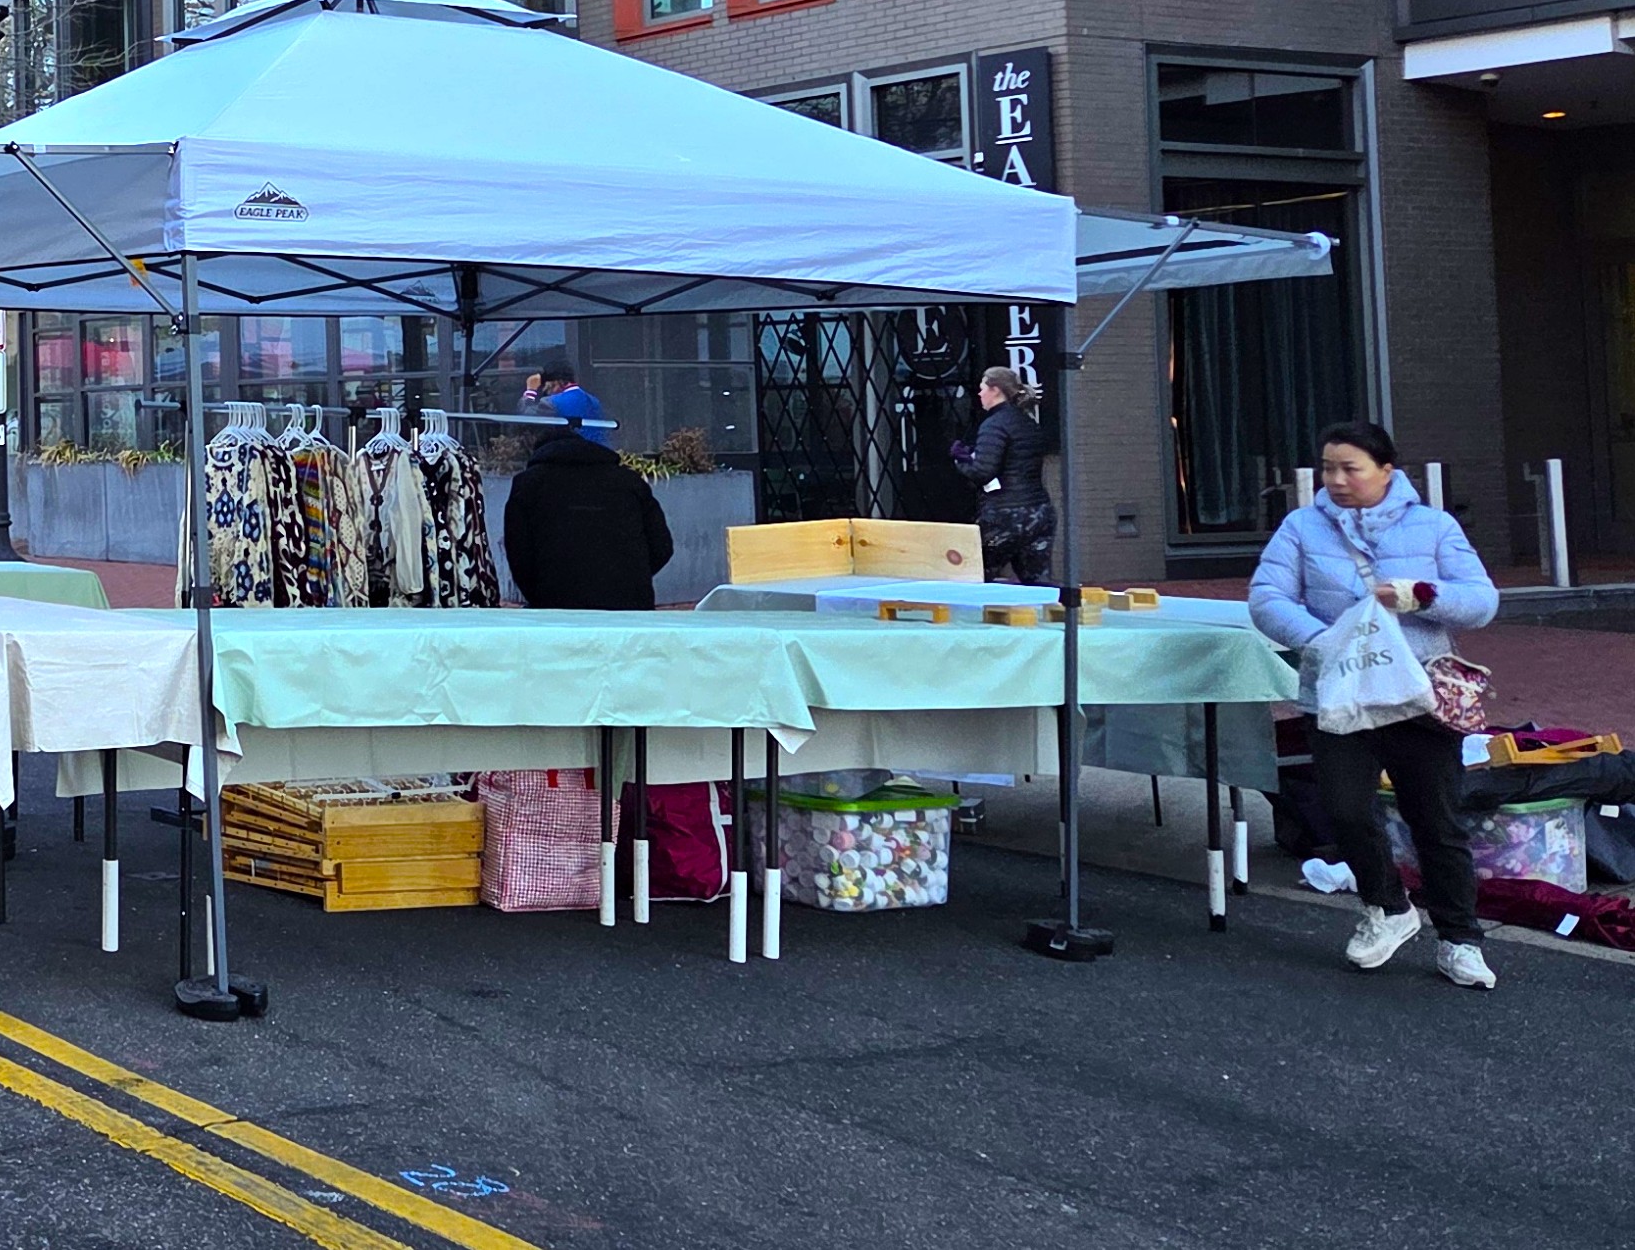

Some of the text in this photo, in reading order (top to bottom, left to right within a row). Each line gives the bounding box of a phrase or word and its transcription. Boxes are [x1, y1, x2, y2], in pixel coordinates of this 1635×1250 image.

[993, 62, 1031, 92] the
[239, 207, 303, 219] EAGLE PEAK
